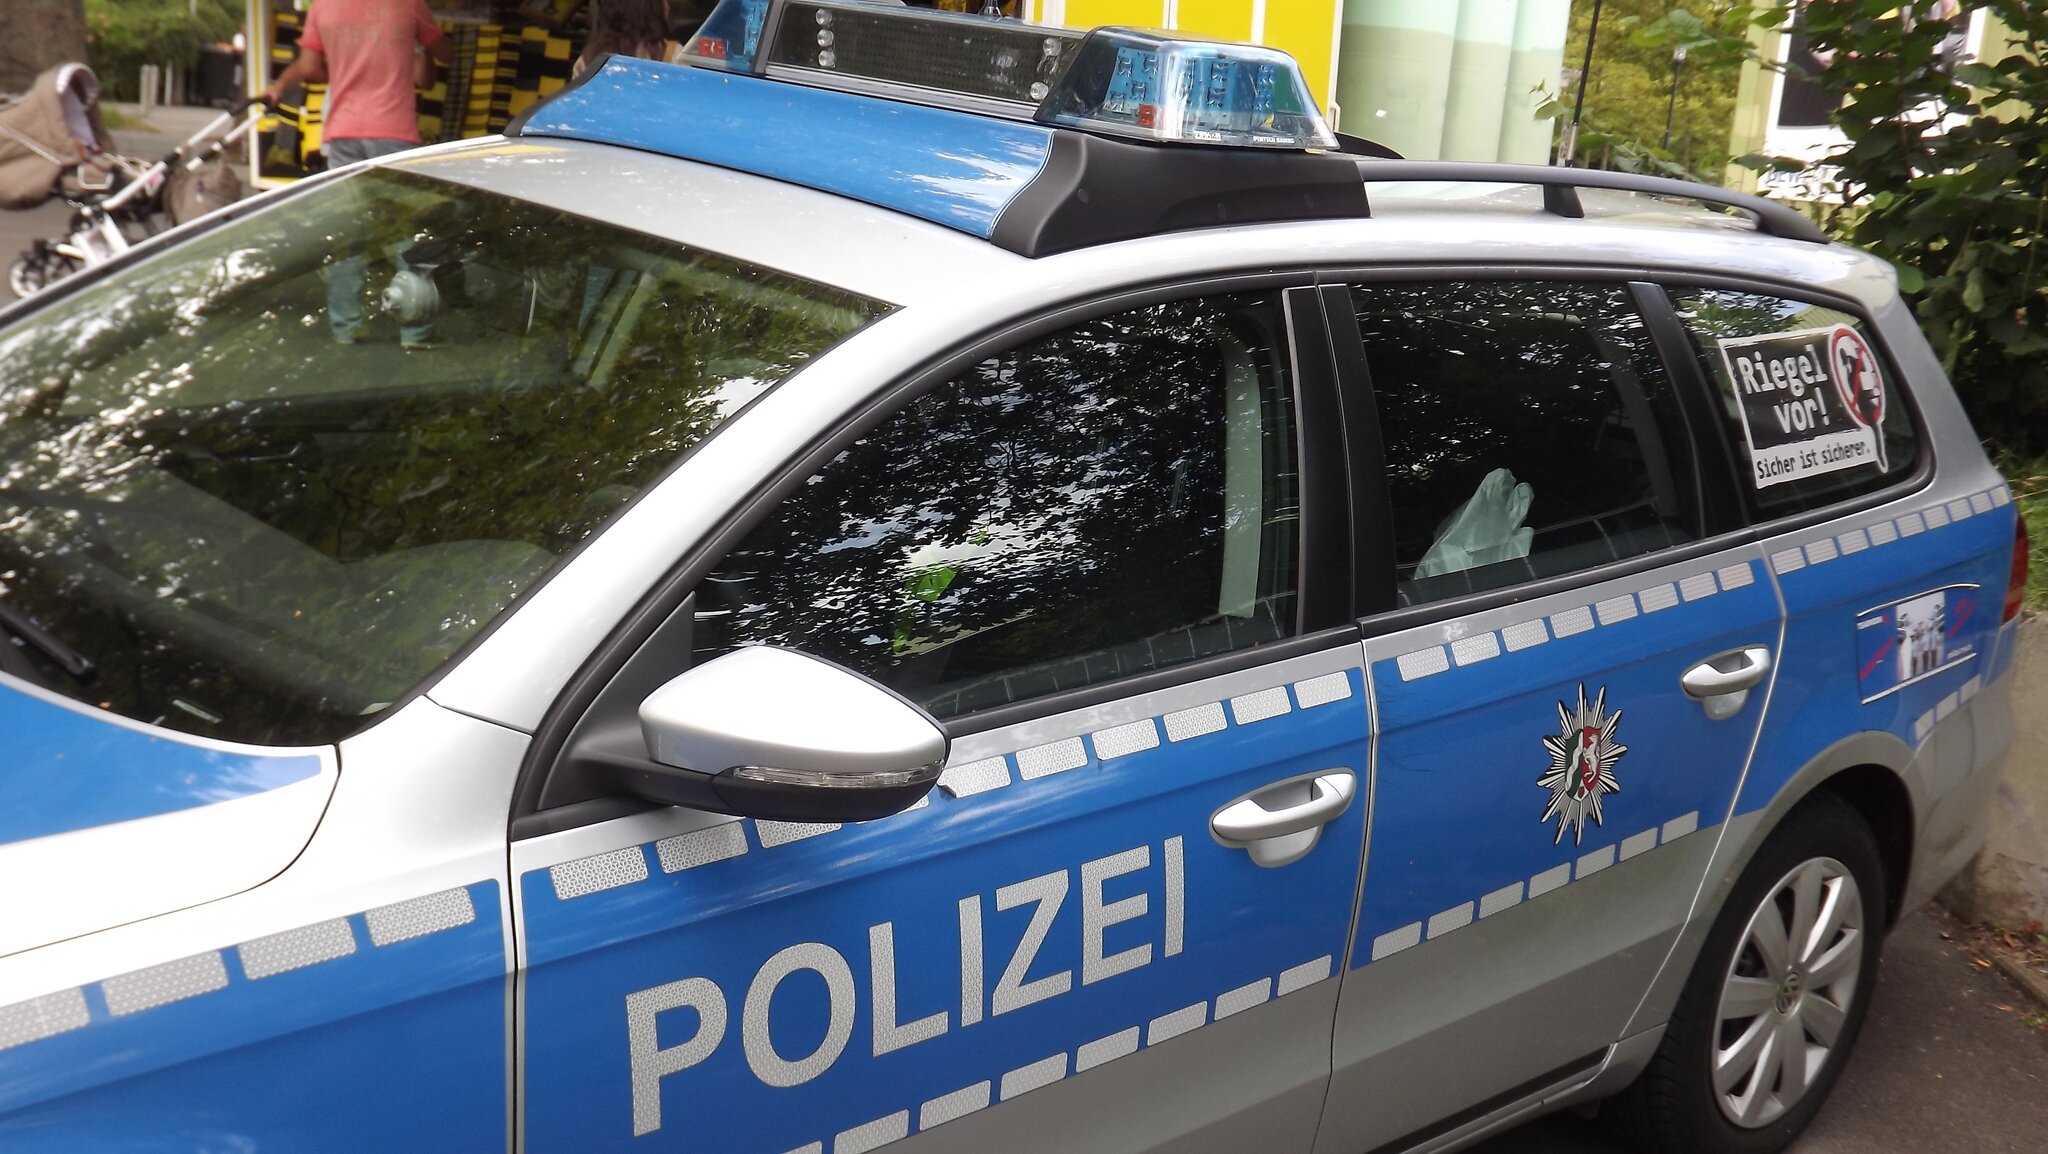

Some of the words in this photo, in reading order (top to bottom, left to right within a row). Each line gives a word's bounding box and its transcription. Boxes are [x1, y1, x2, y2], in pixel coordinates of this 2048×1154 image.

[1737, 344, 1828, 397] Riegel
[1774, 387, 1830, 433] vor!
[1756, 455, 1796, 479] Sicher
[1800, 450, 1820, 469] ist
[1822, 441, 1870, 464] sicherer.
[626, 835, 1184, 1137] POLIZEI
